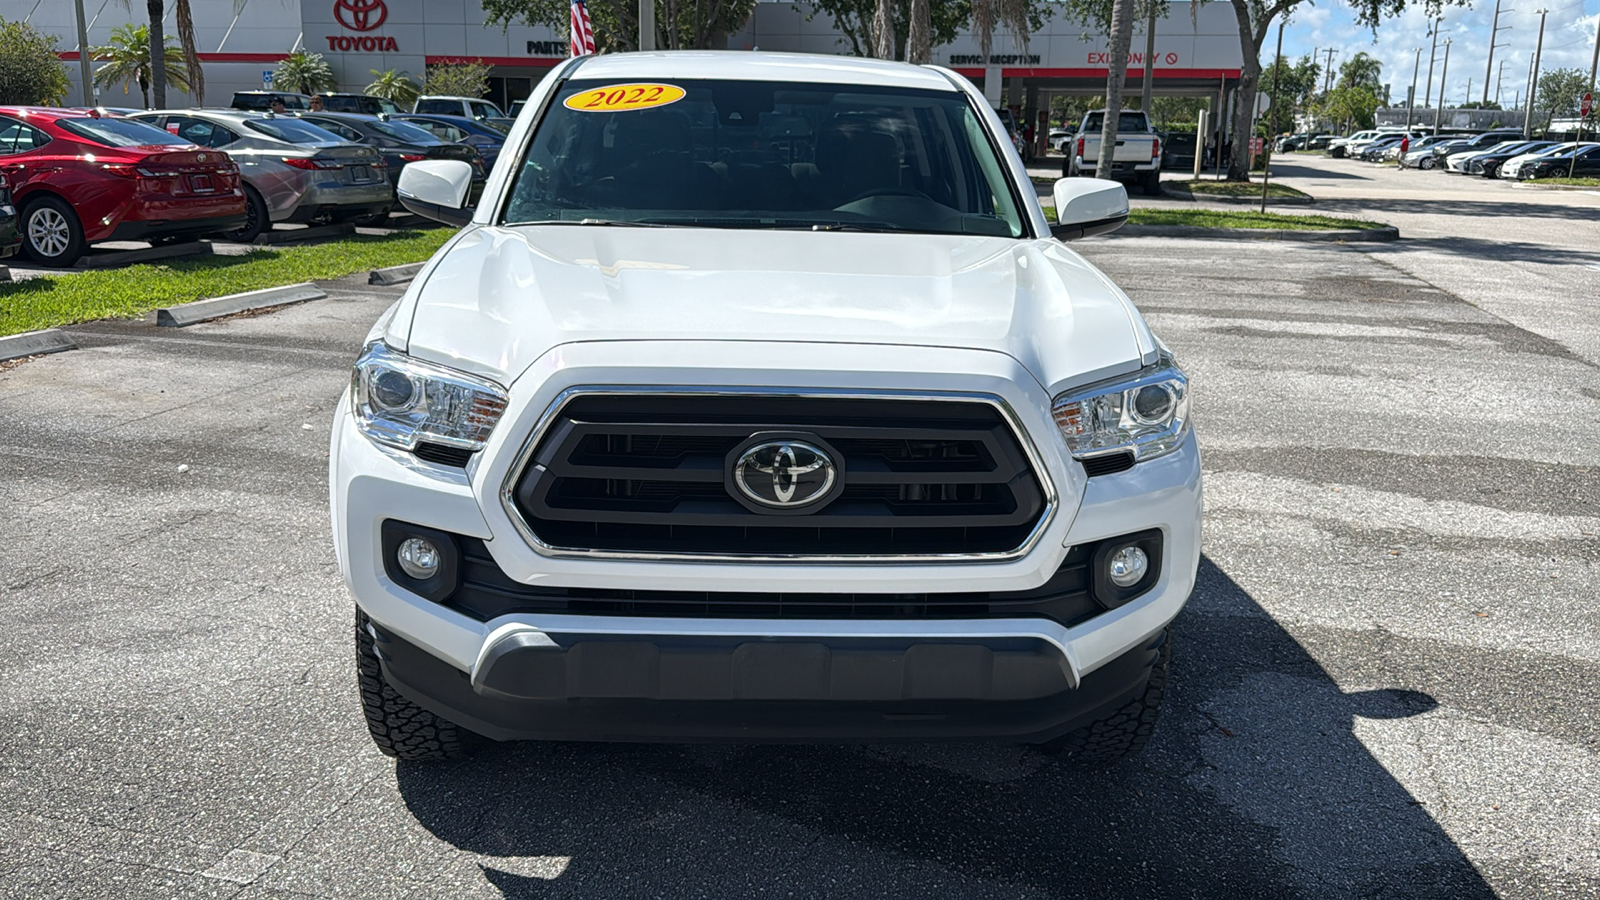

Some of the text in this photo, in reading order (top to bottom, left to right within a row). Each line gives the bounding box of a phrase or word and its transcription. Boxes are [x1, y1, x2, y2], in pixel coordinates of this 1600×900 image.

[325, 36, 399, 52] TOYOTA
[527, 41, 567, 55] PARTS
[949, 55, 1040, 64] SERVIC RECEPTION
[1087, 52, 1111, 64] EXI
[584, 87, 664, 107] 2022
